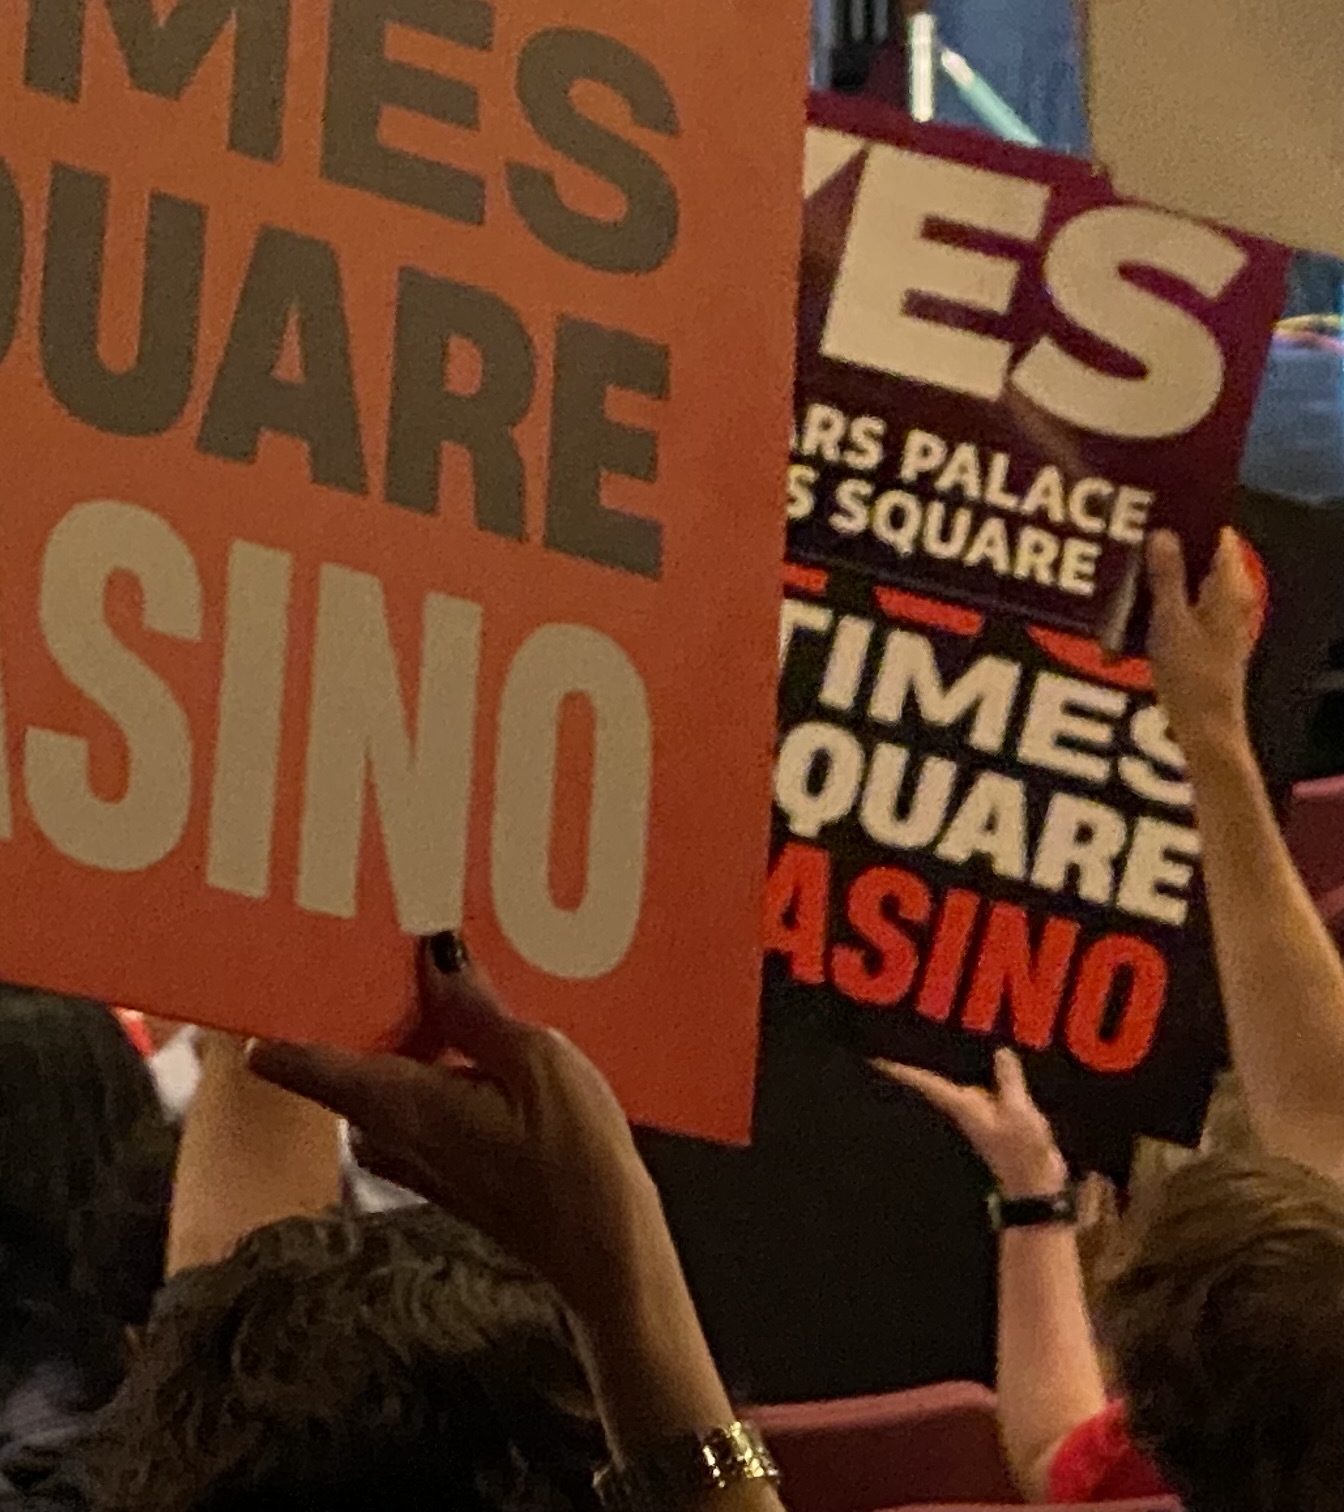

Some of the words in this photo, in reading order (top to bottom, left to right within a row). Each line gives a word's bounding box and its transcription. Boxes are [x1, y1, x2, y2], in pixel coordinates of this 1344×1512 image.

[803, 123, 1250, 442] ES
[829, 476, 1103, 597] SQUARE
[897, 426, 1157, 544] PALACE
[773, 720, 1200, 928] QUARE
[762, 839, 1170, 1076] ASINO
